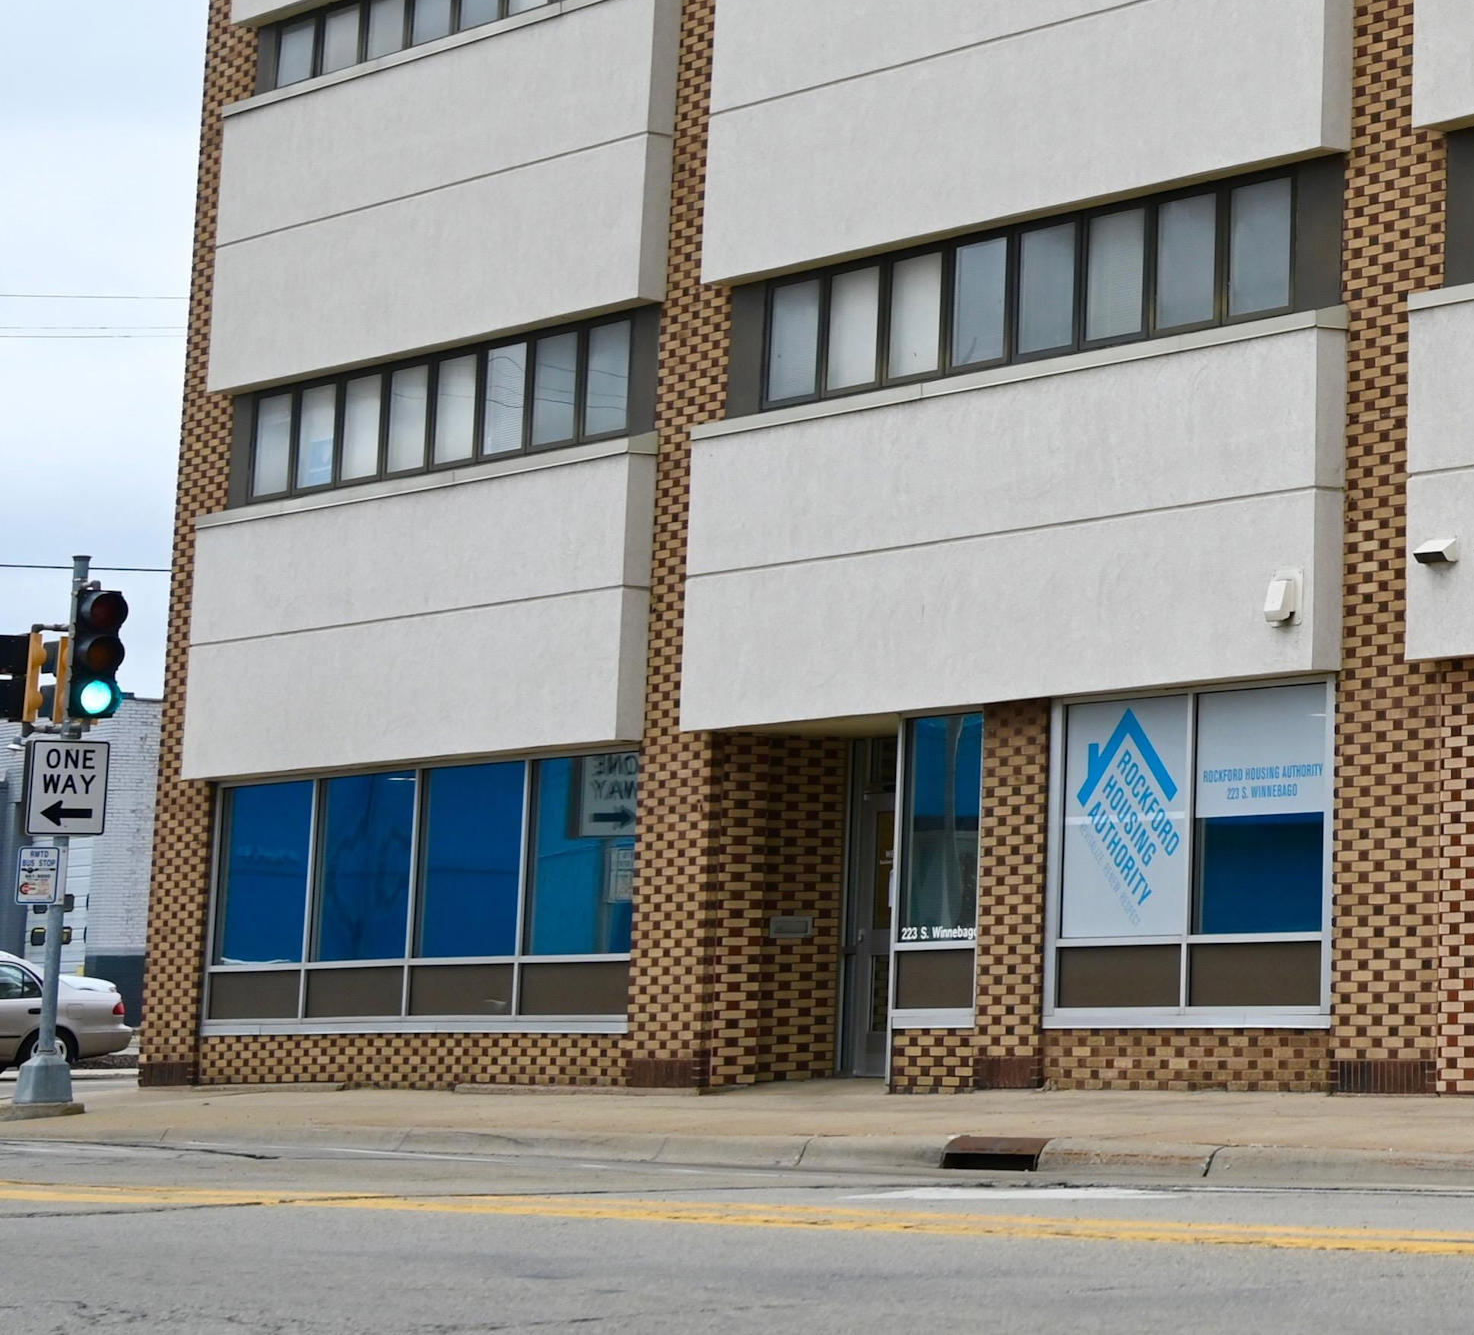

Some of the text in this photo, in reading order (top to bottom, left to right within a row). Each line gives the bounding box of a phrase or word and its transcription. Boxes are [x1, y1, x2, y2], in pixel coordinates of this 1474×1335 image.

[46, 748, 96, 770] ONE
[1203, 763, 1324, 783] ROCKFORD HOUSING AUTHORITY
[43, 774, 96, 795] WAY
[1227, 783, 1298, 800] 223 S. WINNEBAGO
[1117, 749, 1180, 856] ROCKFORD
[1102, 775, 1156, 867] HOUSING
[22, 859, 56, 867] BUS STOP
[1088, 801, 1152, 906] AUTHORITY
[901, 927, 918, 940] 223
[920, 926, 930, 940] S.
